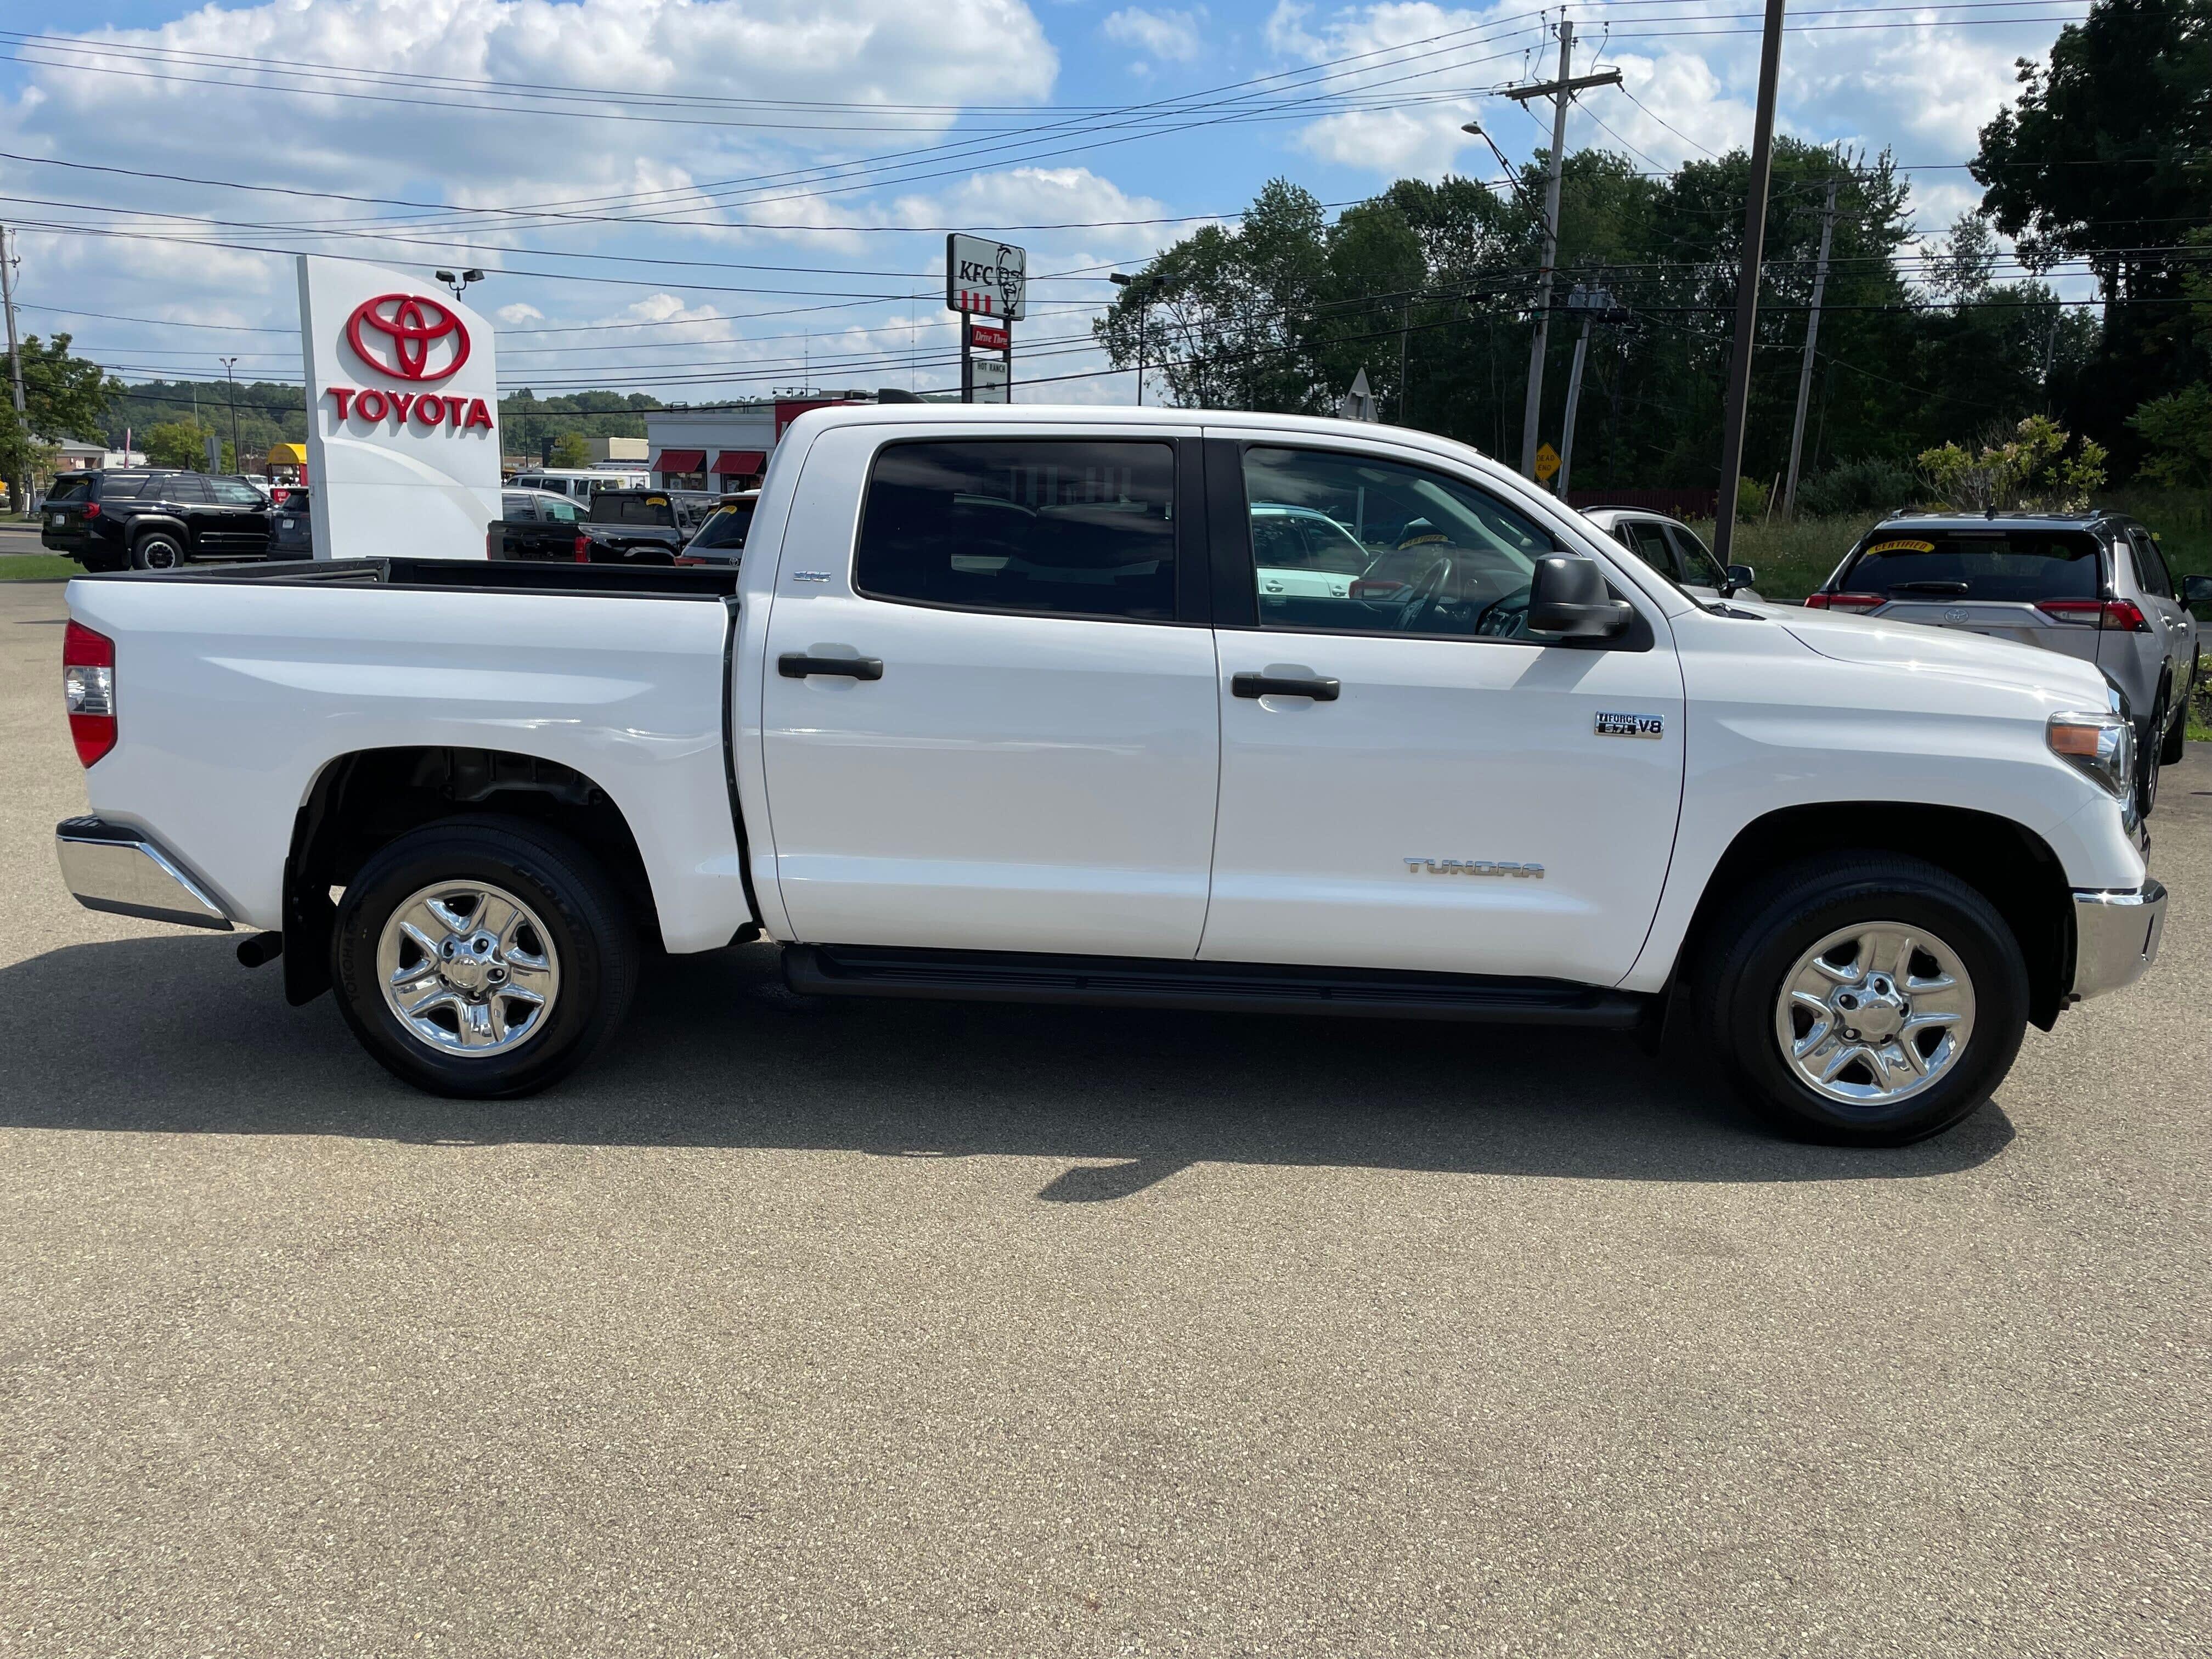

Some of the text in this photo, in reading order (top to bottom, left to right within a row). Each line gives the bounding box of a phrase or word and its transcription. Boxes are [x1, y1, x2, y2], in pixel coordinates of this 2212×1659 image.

[959, 260, 994, 285] KFC
[975, 331, 992, 342] Drive
[977, 362, 987, 371] HOT
[327, 387, 494, 428] TOYOTA
[1875, 541, 1928, 551] CERTIFIED
[1638, 719, 1662, 733] V8
[1403, 857, 1545, 878] TUNDRA
